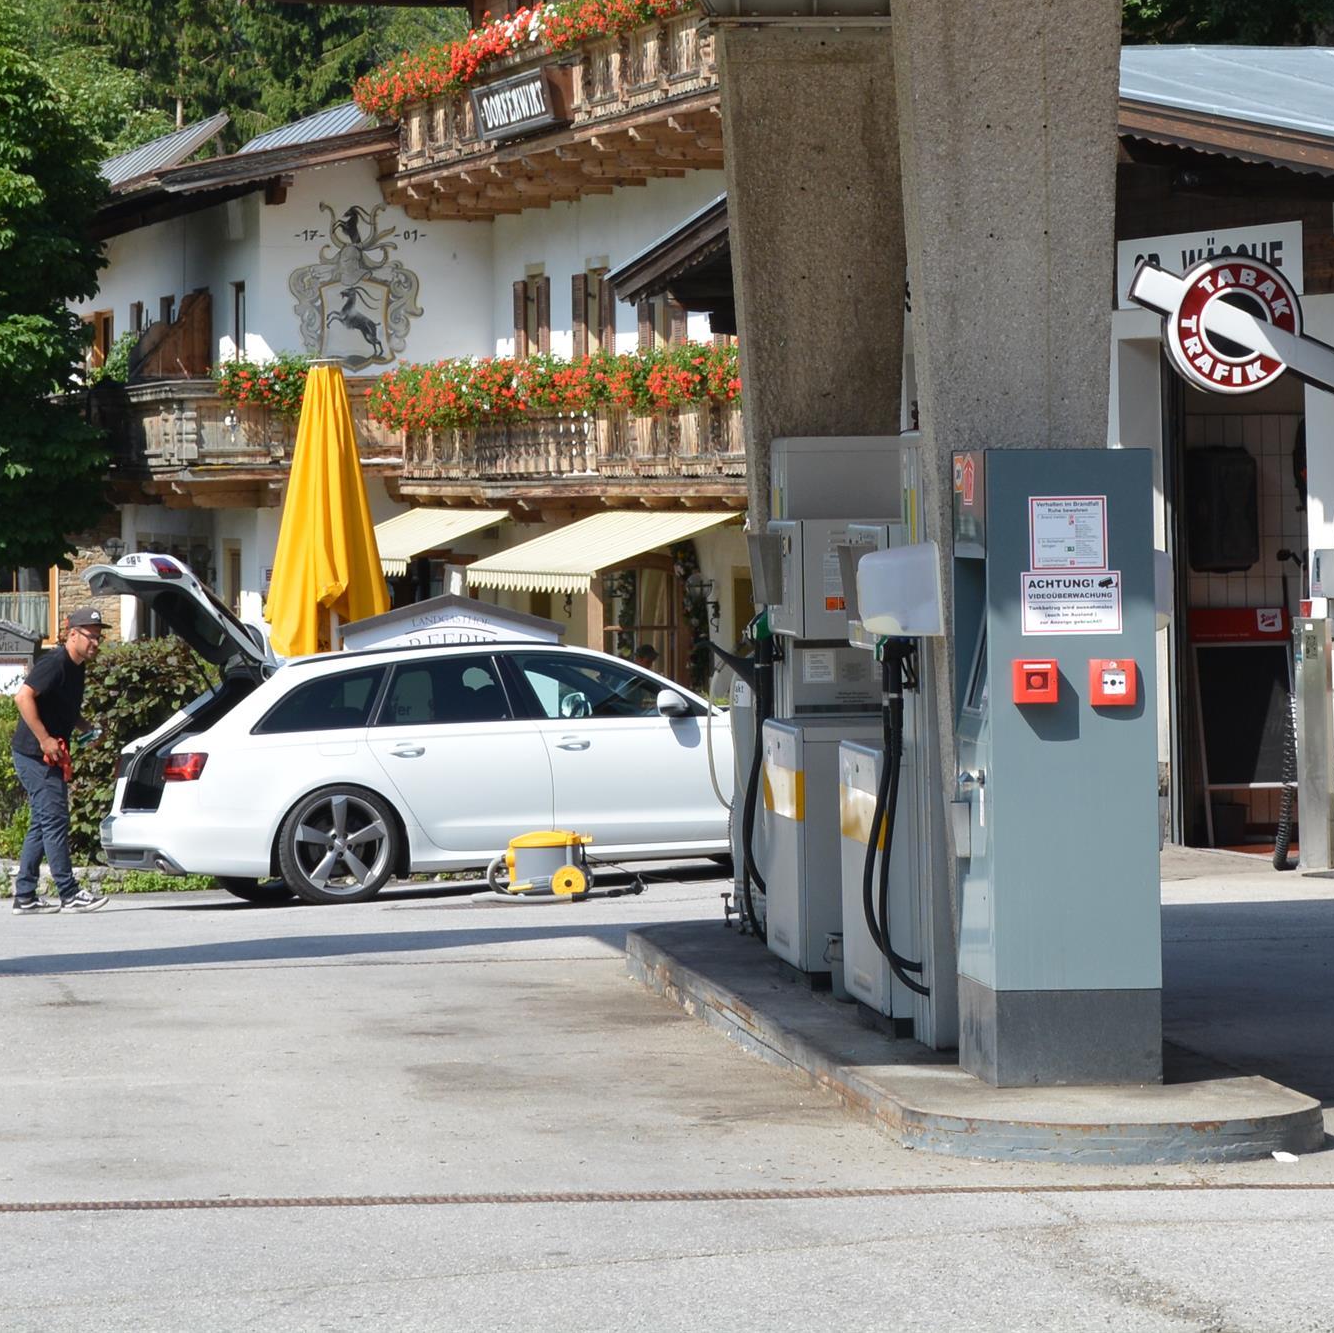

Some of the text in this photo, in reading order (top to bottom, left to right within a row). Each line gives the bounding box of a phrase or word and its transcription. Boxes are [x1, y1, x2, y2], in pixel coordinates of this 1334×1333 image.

[1198, 268, 1292, 317] TABAK
[1181, 315, 1267, 384] TRAFIK
[1028, 578, 1094, 588] ACHTUNG!
[411, 615, 491, 628] LANDGASTHOF
